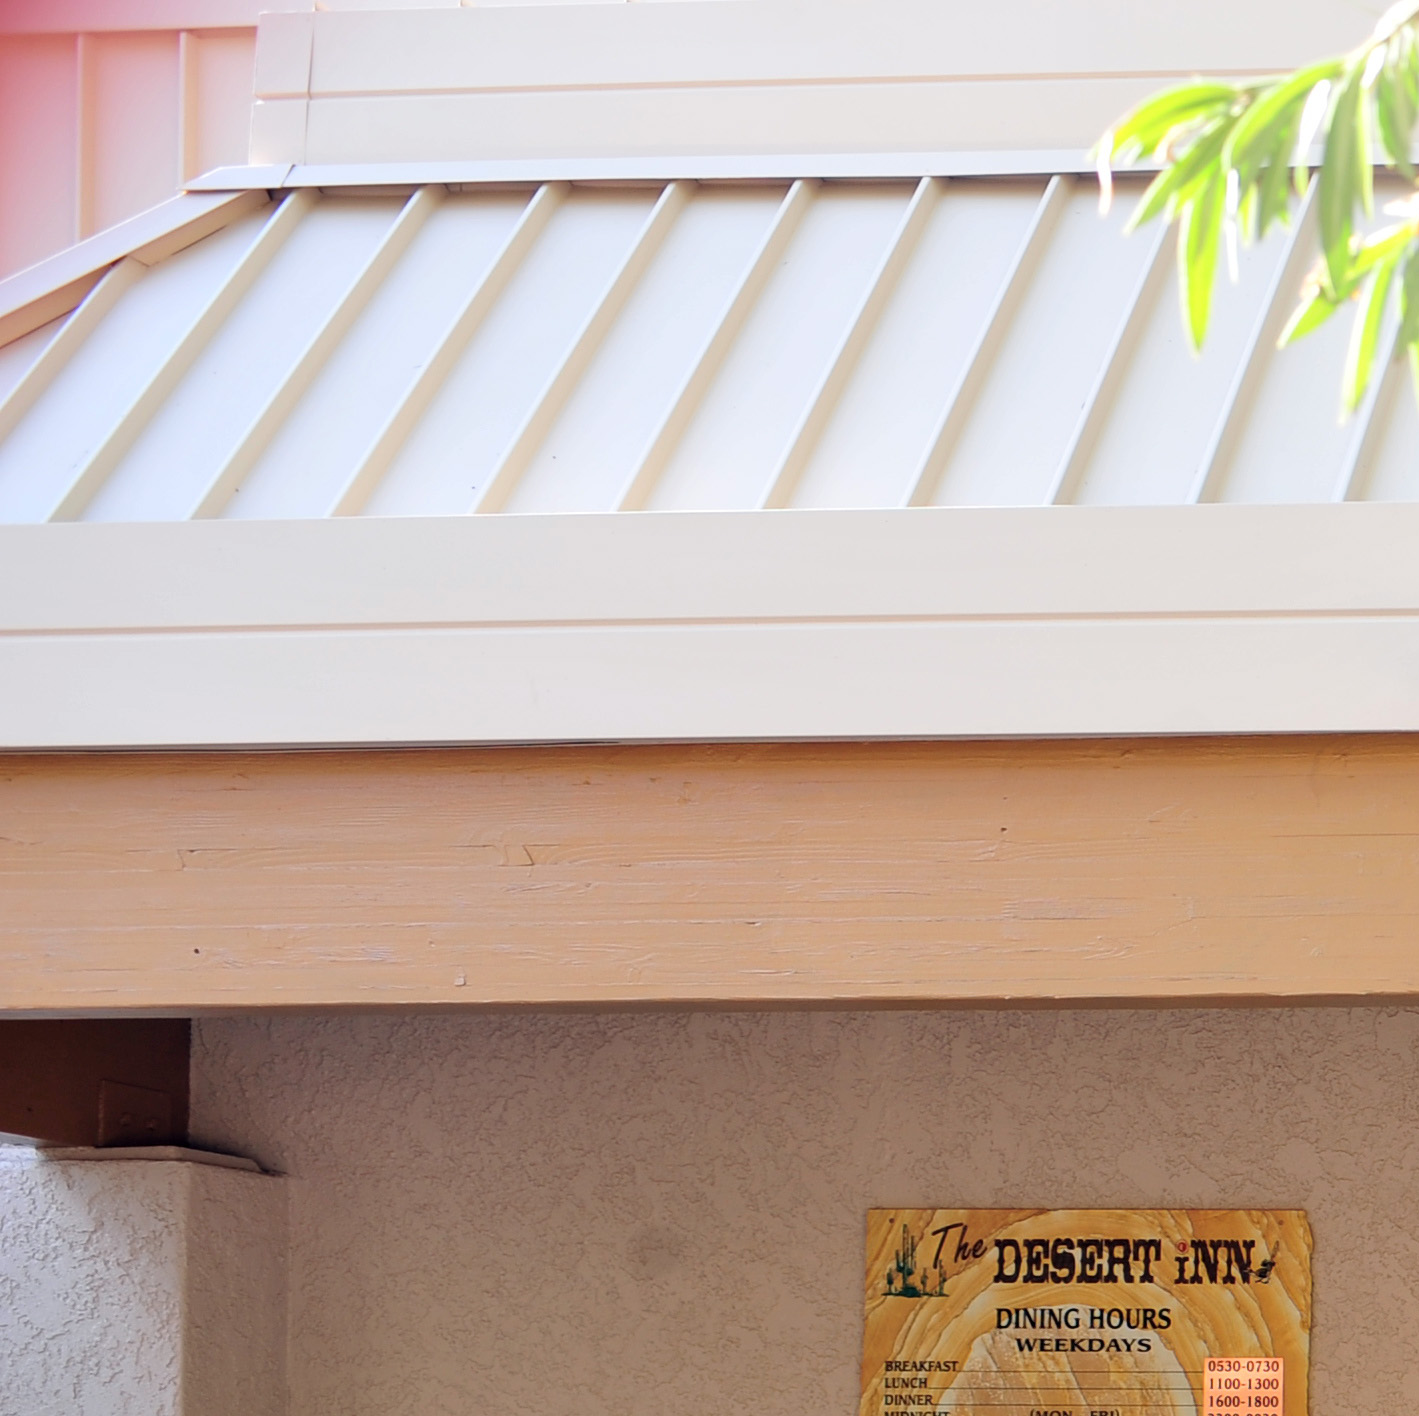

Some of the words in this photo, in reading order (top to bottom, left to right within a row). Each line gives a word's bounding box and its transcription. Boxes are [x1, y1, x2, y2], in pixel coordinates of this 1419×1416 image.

[931, 1222, 988, 1270] The
[994, 1237, 1161, 1284] DESERT
[995, 1308, 1080, 1330] DINING
[1089, 1307, 1172, 1330] HOURS
[1016, 1338, 1152, 1353] WEEKDAYS
[884, 1360, 959, 1372] BREAKFAST
[1208, 1360, 1279, 1372] 0530-0730
[884, 1377, 928, 1389] LUNCH
[1209, 1378, 1279, 1390] 1100-1300
[884, 1394, 933, 1406] DINNER
[1210, 1395, 1279, 1407] 1600-1800
